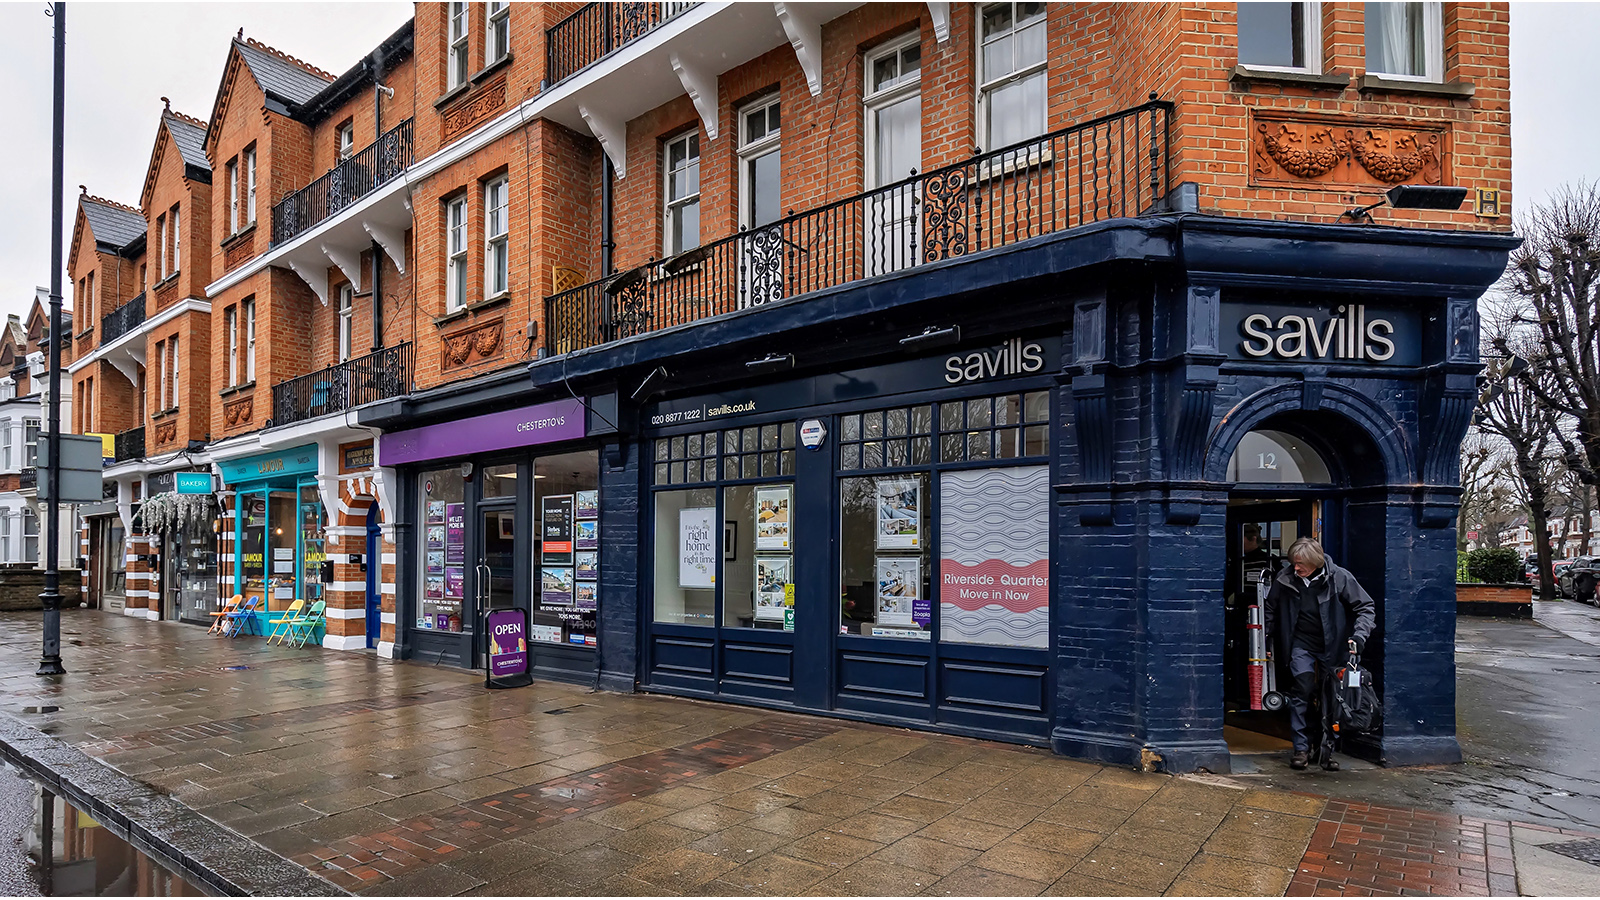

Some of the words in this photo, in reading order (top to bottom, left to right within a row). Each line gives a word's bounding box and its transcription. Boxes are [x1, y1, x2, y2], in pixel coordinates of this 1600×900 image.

[1243, 304, 1395, 361] savills
[944, 337, 1043, 384] savills
[651, 416, 664, 425] 020
[665, 412, 683, 423] 8877
[684, 409, 701, 420] 1222
[708, 400, 756, 417] savills.co.uk
[257, 458, 285, 474] LAMOUR
[1257, 452, 1278, 470] 12
[688, 529, 708, 543] right
[685, 540, 711, 551] home
[244, 553, 263, 562] LAMOUR
[305, 552, 327, 562] LAMOUR
[683, 555, 699, 566] right
[944, 573, 995, 585] Riverside
[1000, 574, 1049, 587] Quarter
[959, 588, 989, 599] Move
[991, 589, 1002, 600] in
[1004, 589, 1030, 600] Now
[913, 610, 931, 618] Zoopla
[495, 623, 521, 636] OPEN
[496, 658, 523, 667] CHESTERTONS
